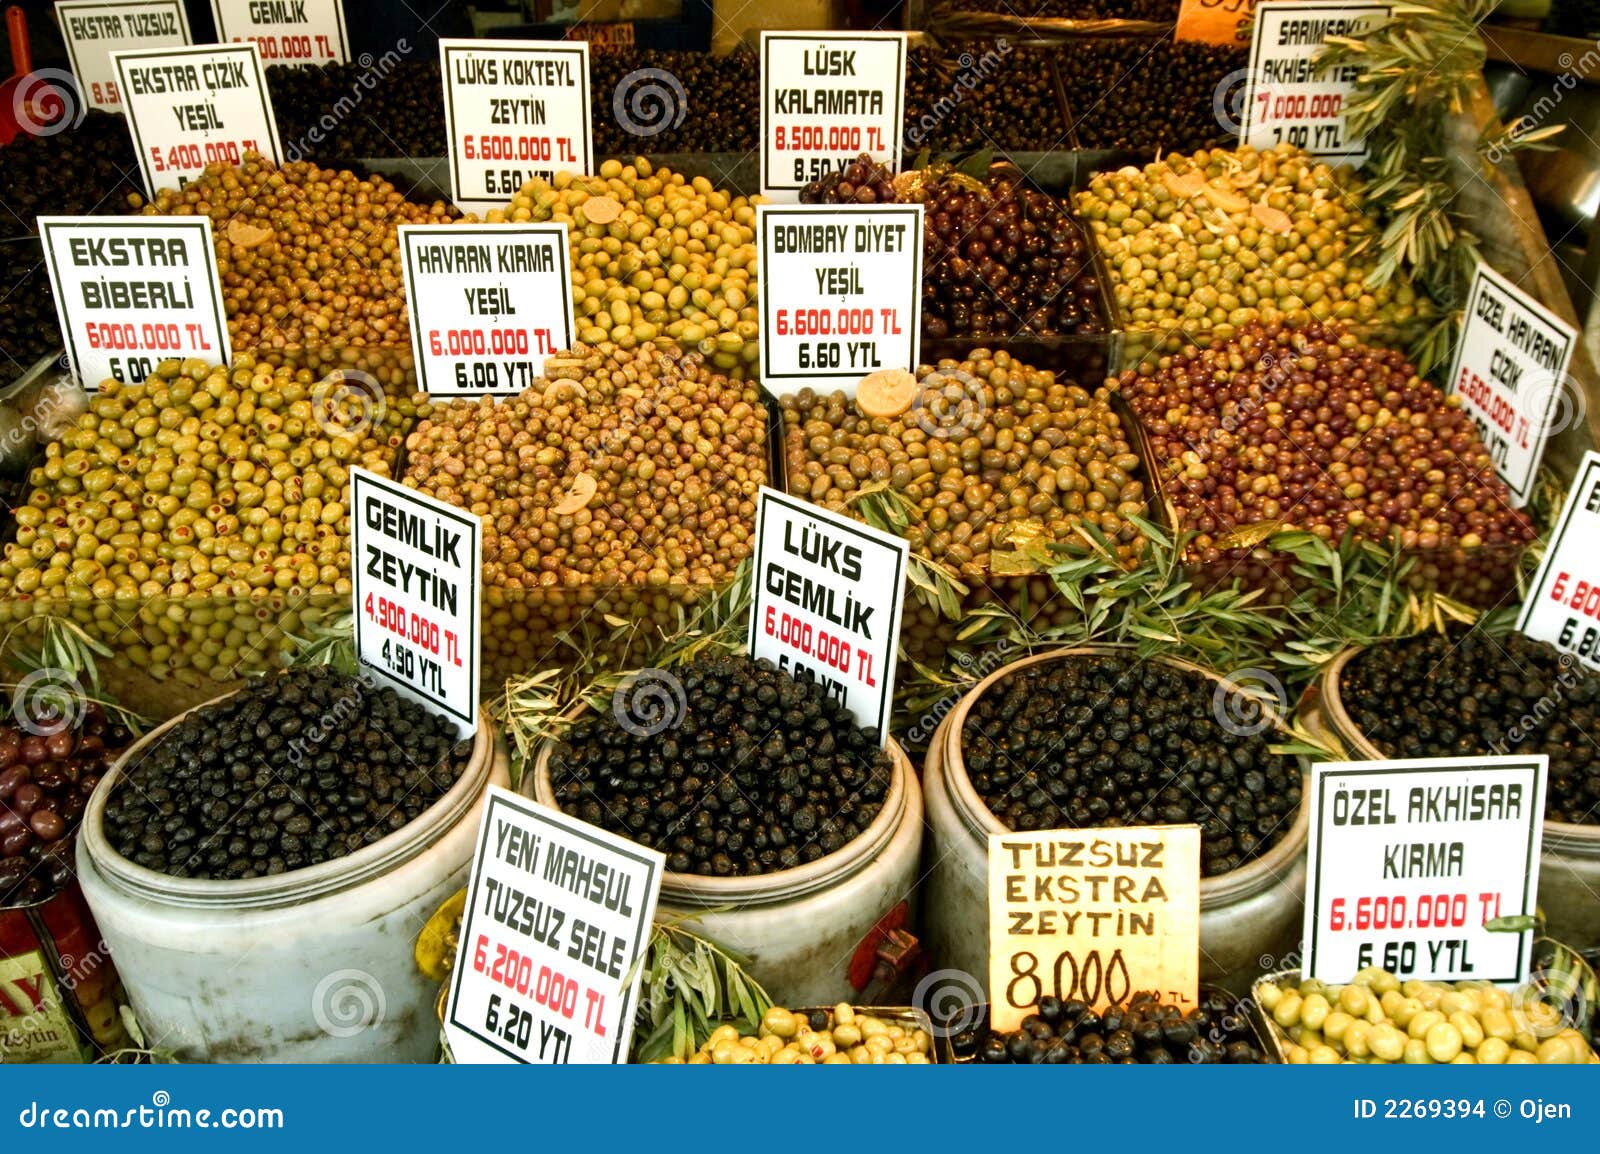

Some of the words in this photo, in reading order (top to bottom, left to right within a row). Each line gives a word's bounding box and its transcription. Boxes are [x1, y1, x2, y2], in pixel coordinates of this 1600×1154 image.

[70, 15, 124, 40] EKSTRA
[124, 12, 178, 38] TUZSUZ
[315, 35, 335, 58] TL
[804, 44, 856, 76] LÜSK
[129, 65, 200, 95] EKSTRA
[202, 56, 249, 97] ÇİZİK
[456, 53, 498, 85] LÜKS
[503, 59, 575, 87] KOKTEYL
[91, 81, 122, 104] 8.5
[774, 88, 883, 115] KALAMATA
[1257, 92, 1342, 123] 7.000.000
[172, 98, 224, 137] YEŞİL
[490, 94, 546, 125] ZEYTİN
[464, 135, 551, 161] 6.600.000
[556, 138, 577, 162] TL
[775, 126, 861, 151] 8.500.000
[866, 127, 885, 151] TL
[1314, 125, 1341, 148] YTL
[150, 141, 240, 171] 5.400.000
[794, 158, 831, 182] 8.50
[485, 169, 523, 194] 6.60
[69, 237, 189, 267] EKSTRA
[774, 225, 848, 253] BOMBAY
[855, 218, 906, 253] DİYET
[417, 245, 492, 274] HAVRAN
[497, 244, 555, 273] KIRMA
[80, 275, 194, 309] BİBERLİ
[816, 261, 864, 303] YEŞİL
[464, 281, 516, 323] YEŞİL
[185, 323, 211, 350] TL
[776, 308, 874, 336] 6.600.000
[880, 308, 901, 335] TL
[1476, 285, 1506, 334] ÖZEL
[1507, 312, 1563, 370] HAVRAN
[429, 328, 528, 356] 6.000.000
[534, 328, 558, 355] TL
[798, 342, 840, 368] 6.60
[847, 341, 881, 368] YTL
[455, 362, 498, 389] 6.00
[1516, 418, 1531, 450] TL
[1491, 434, 1510, 471] YTL
[365, 496, 461, 569] GEMLİK
[783, 519, 863, 582] LÜKS
[366, 543, 457, 617] ZEYTİN
[766, 562, 875, 640] GEMLİK
[365, 592, 439, 655] 4.900.000
[444, 629, 462, 667] TL
[765, 605, 851, 674] 6.000.000
[857, 648, 876, 688] TL
[382, 638, 414, 681] 4.90
[419, 655, 446, 699] YTL
[1333, 781, 1396, 826] ÖZEL
[1408, 777, 1522, 823] AKHİSAR
[495, 818, 541, 875] YENİ
[543, 842, 633, 919] MAHSUL
[1001, 838, 1164, 869] TUZSUZ
[1383, 842, 1464, 880] KIRMA
[1006, 875, 1169, 904] EKSTRA
[484, 877, 566, 951] TUZSUZ
[567, 919, 627, 980] SELE
[1008, 908, 1154, 937] ZEYTİN
[1330, 893, 1467, 932] 6.600.000
[1428, 939, 1474, 974] YTL
[473, 934, 579, 1020] 6.200.000
[584, 987, 607, 1037] TL
[485, 993, 533, 1050] 6.20
